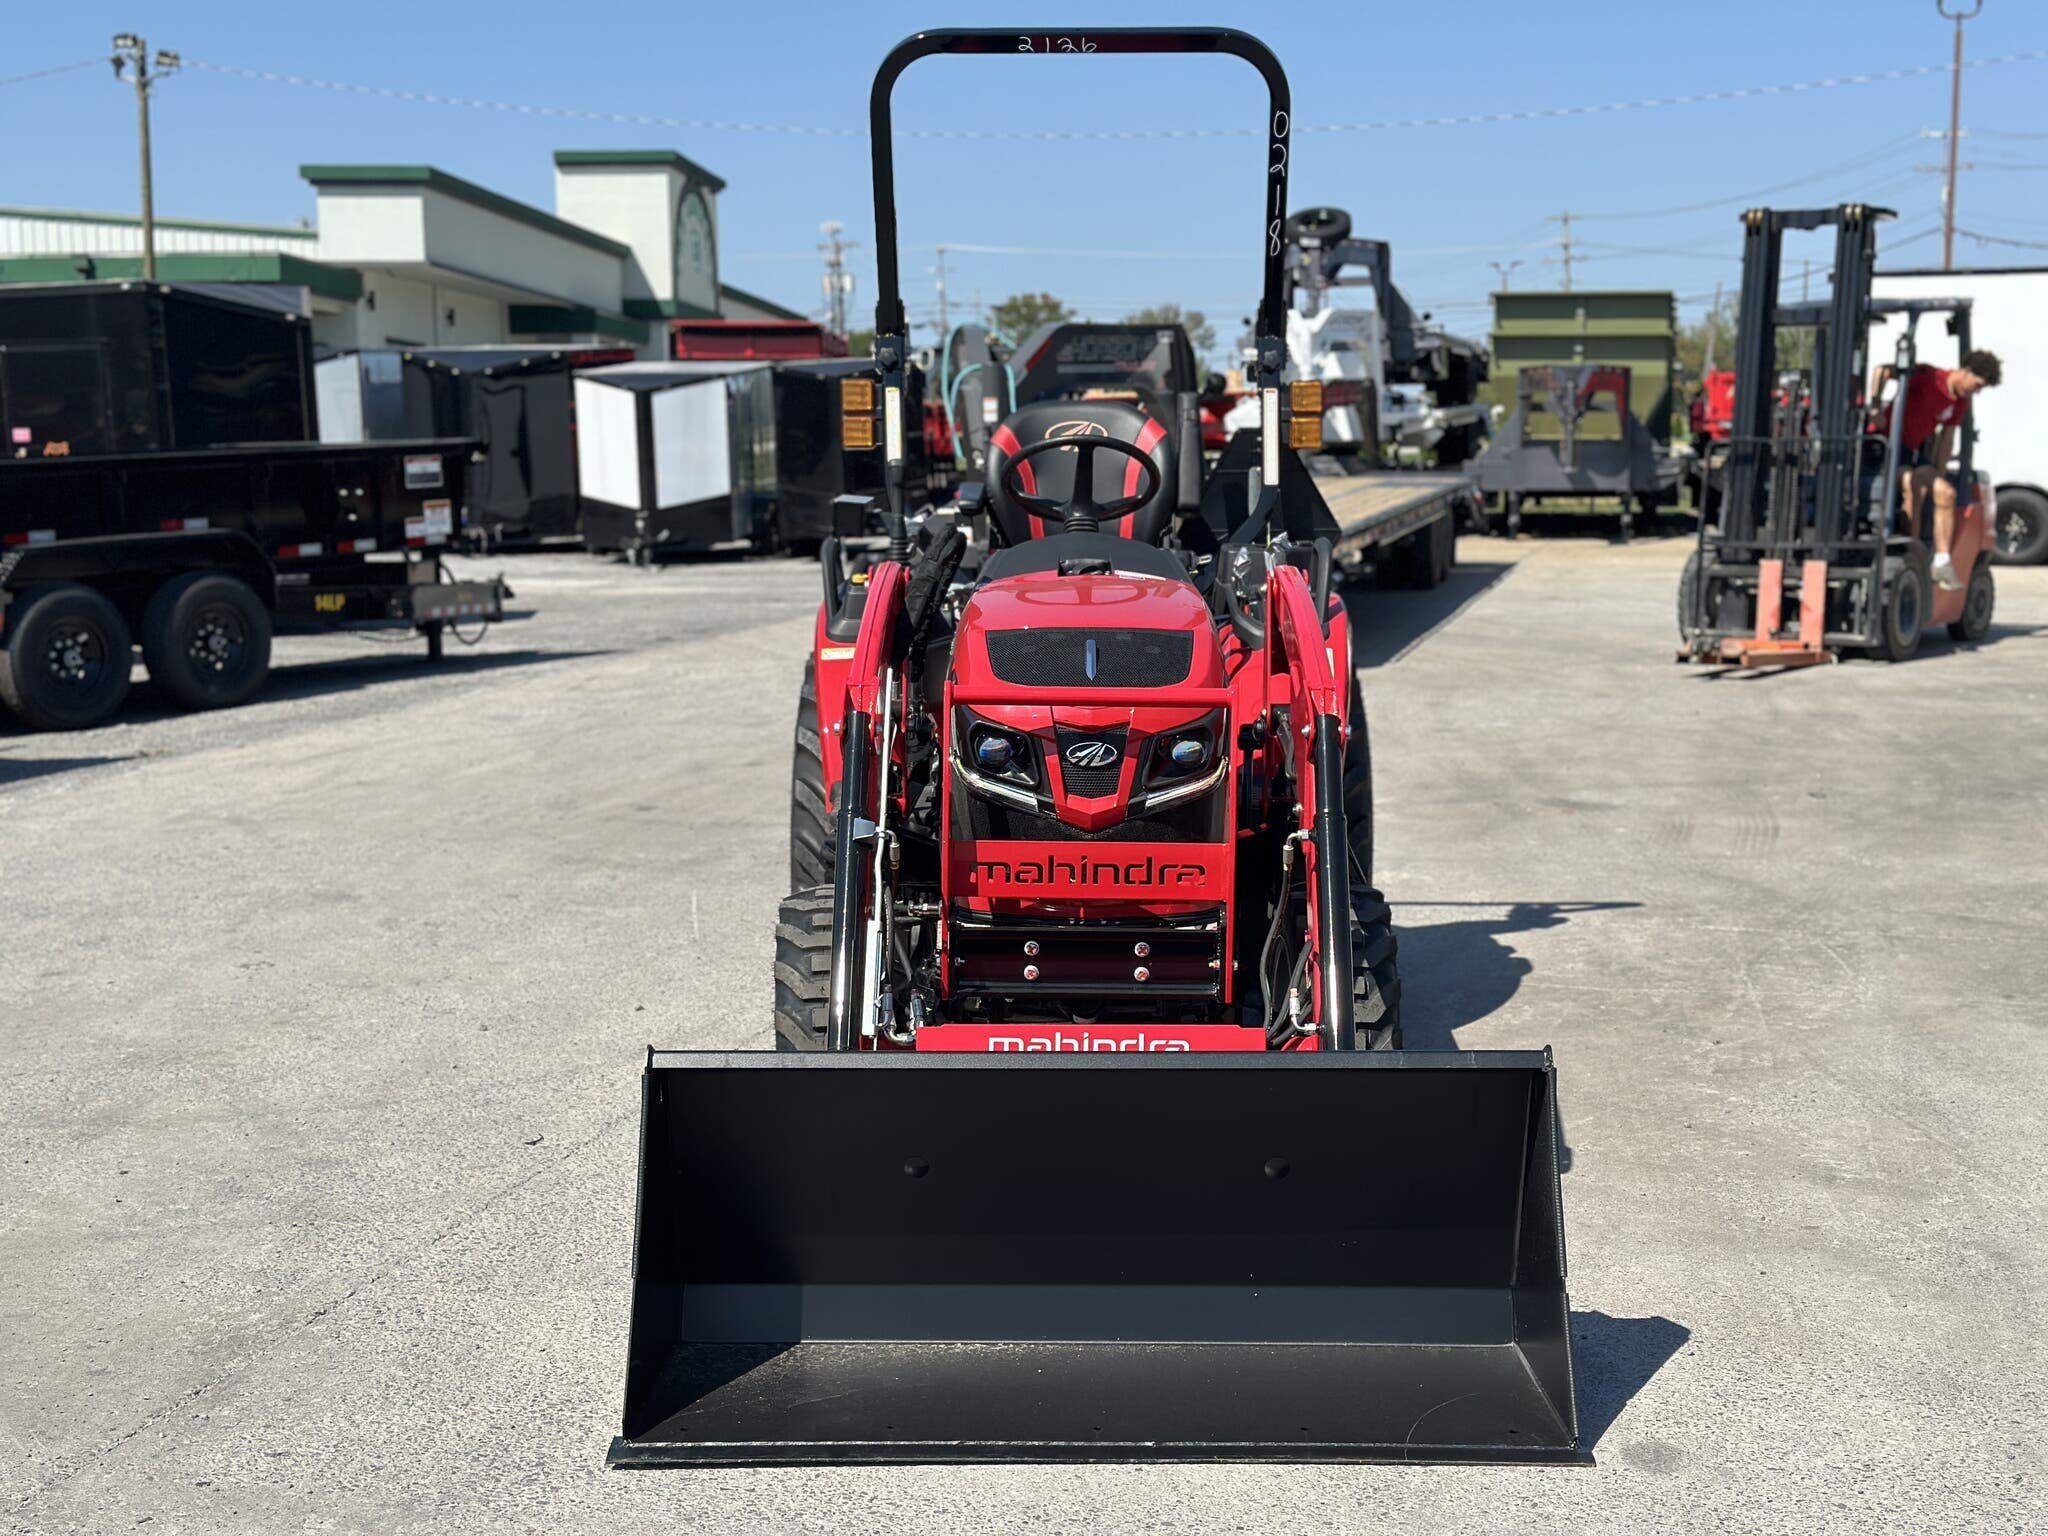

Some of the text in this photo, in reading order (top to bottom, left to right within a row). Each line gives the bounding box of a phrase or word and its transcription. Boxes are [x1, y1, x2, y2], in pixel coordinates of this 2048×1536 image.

[1018, 36, 1098, 53] 2126
[1269, 110, 1289, 257] 0218
[970, 854, 1207, 887] mahindra
